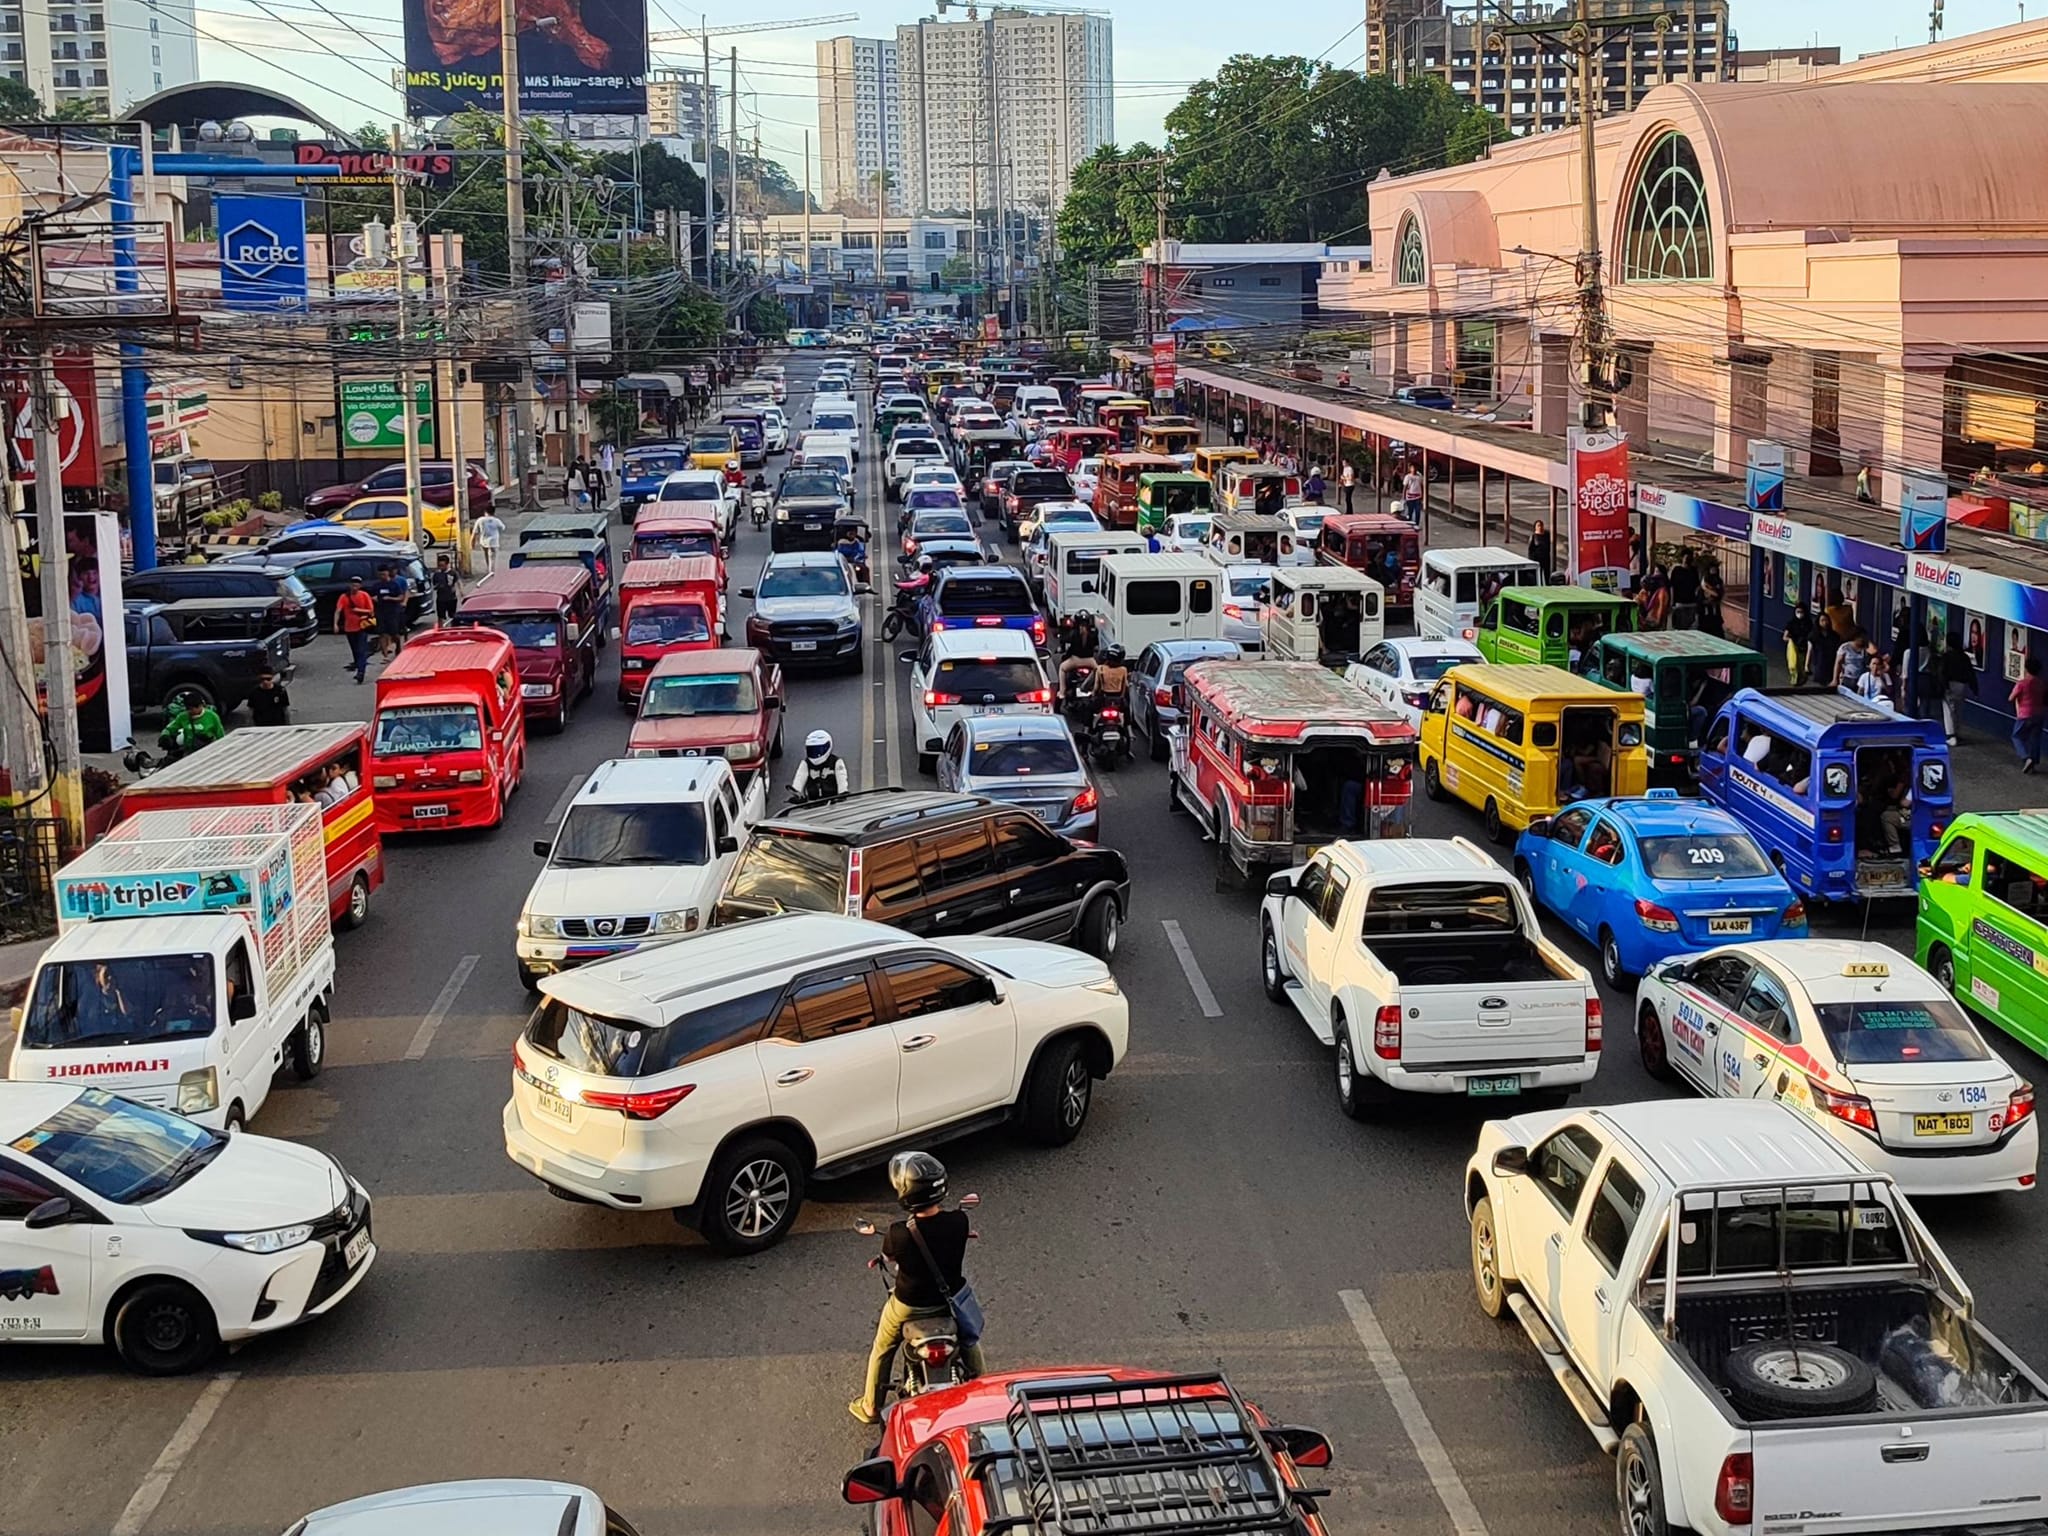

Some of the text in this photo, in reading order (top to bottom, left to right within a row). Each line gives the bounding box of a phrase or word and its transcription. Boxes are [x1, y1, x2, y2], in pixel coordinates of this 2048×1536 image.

[407, 72, 440, 86] MAS
[443, 72, 486, 91] juicy
[525, 76, 549, 87] MAS
[530, 91, 573, 99] formulation
[340, 176, 377, 184] SEAFOOD
[240, 245, 298, 262] RCBC
[279, 296, 300, 306] ATM
[1581, 492, 1625, 509] Fiesta
[1732, 769, 1767, 796] ROUTE 4
[1687, 848, 1725, 864] 209
[1711, 920, 1728, 931] LAA
[1850, 964, 1886, 974] TAXI
[1678, 1001, 1704, 1032] SOLID
[1722, 1051, 1741, 1081] 1584
[1959, 1086, 1987, 1104] 1584
[1917, 1119, 1938, 1131] NAT
